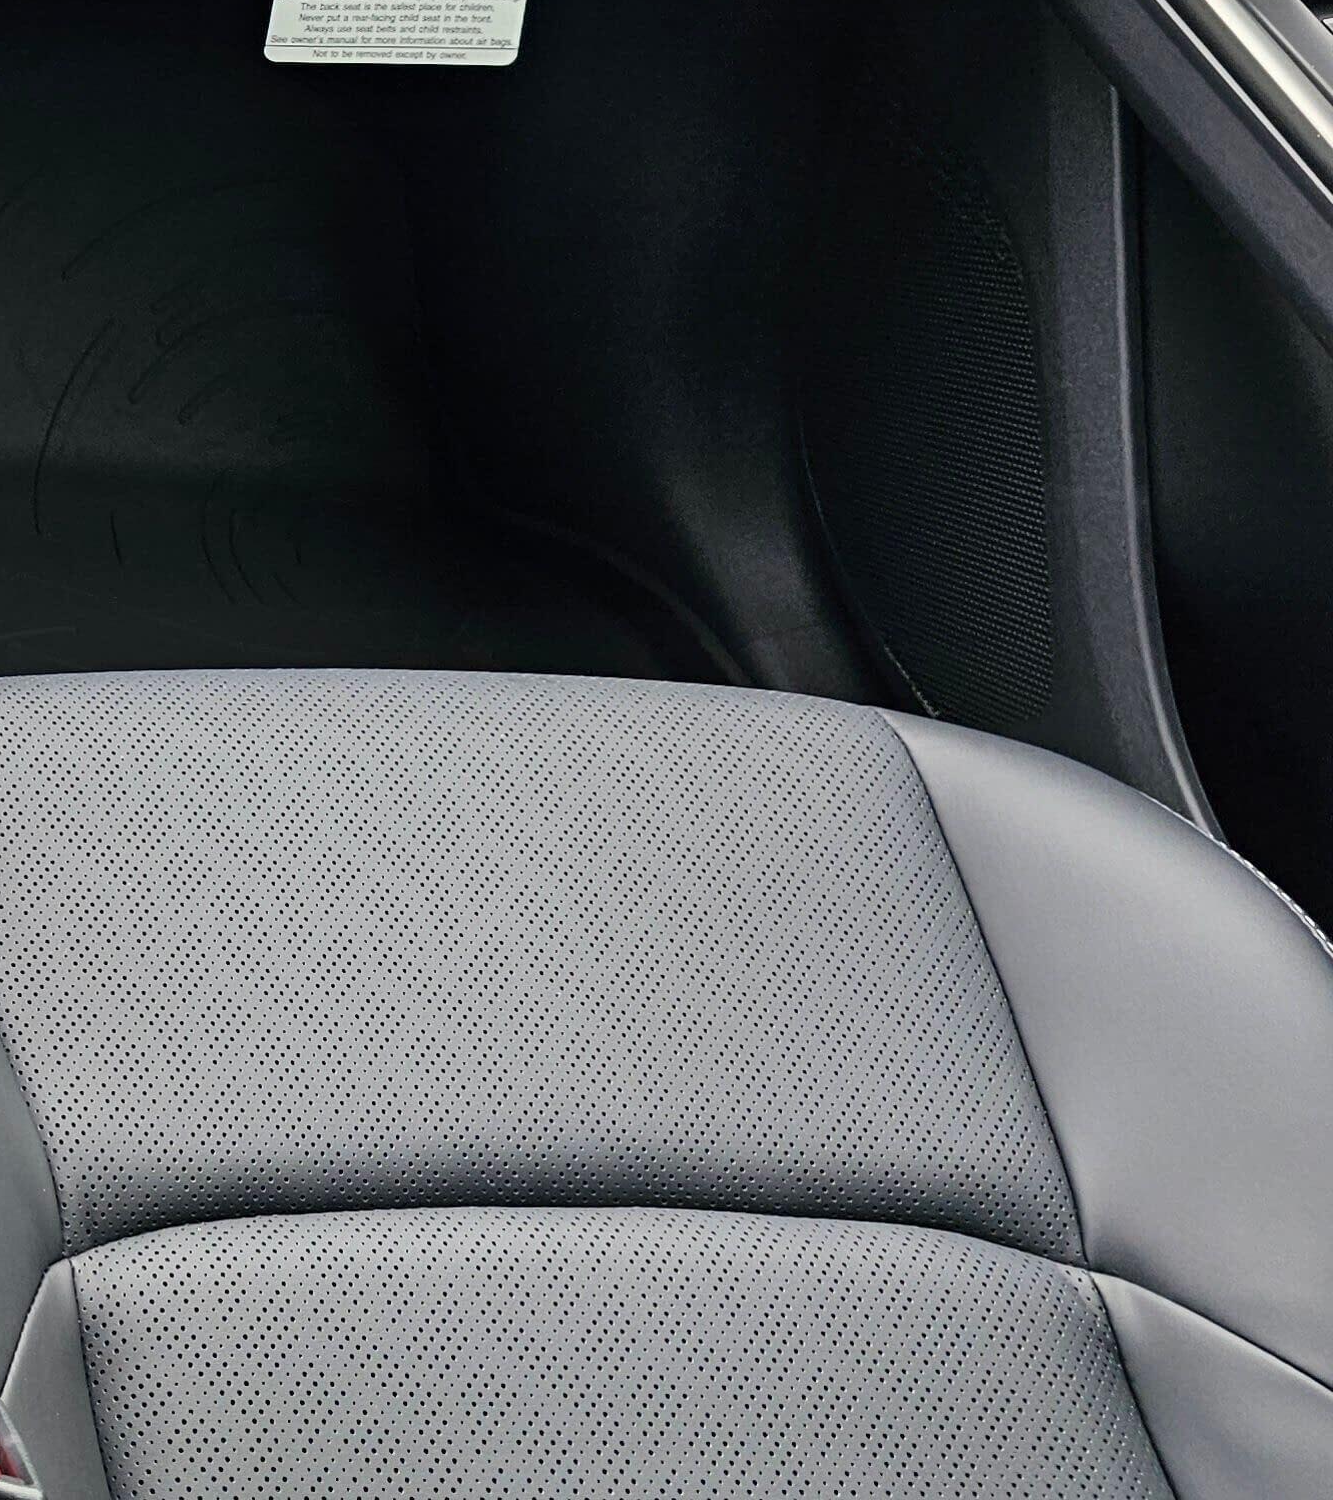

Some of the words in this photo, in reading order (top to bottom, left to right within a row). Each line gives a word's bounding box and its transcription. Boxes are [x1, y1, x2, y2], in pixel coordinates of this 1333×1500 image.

[300, 2, 317, 10] The
[364, 3, 371, 11] is
[374, 3, 388, 11] the
[418, 3, 443, 12] place
[445, 3, 457, 11] for
[299, 13, 324, 21] Never
[326, 14, 341, 23] put
[304, 25, 334, 33] Always
[418, 25, 439, 33] child
[360, 36, 373, 44] for
[341, 50, 353, 58] be
[356, 50, 392, 58] removed
[395, 51, 423, 60] except
[426, 51, 437, 60] by
